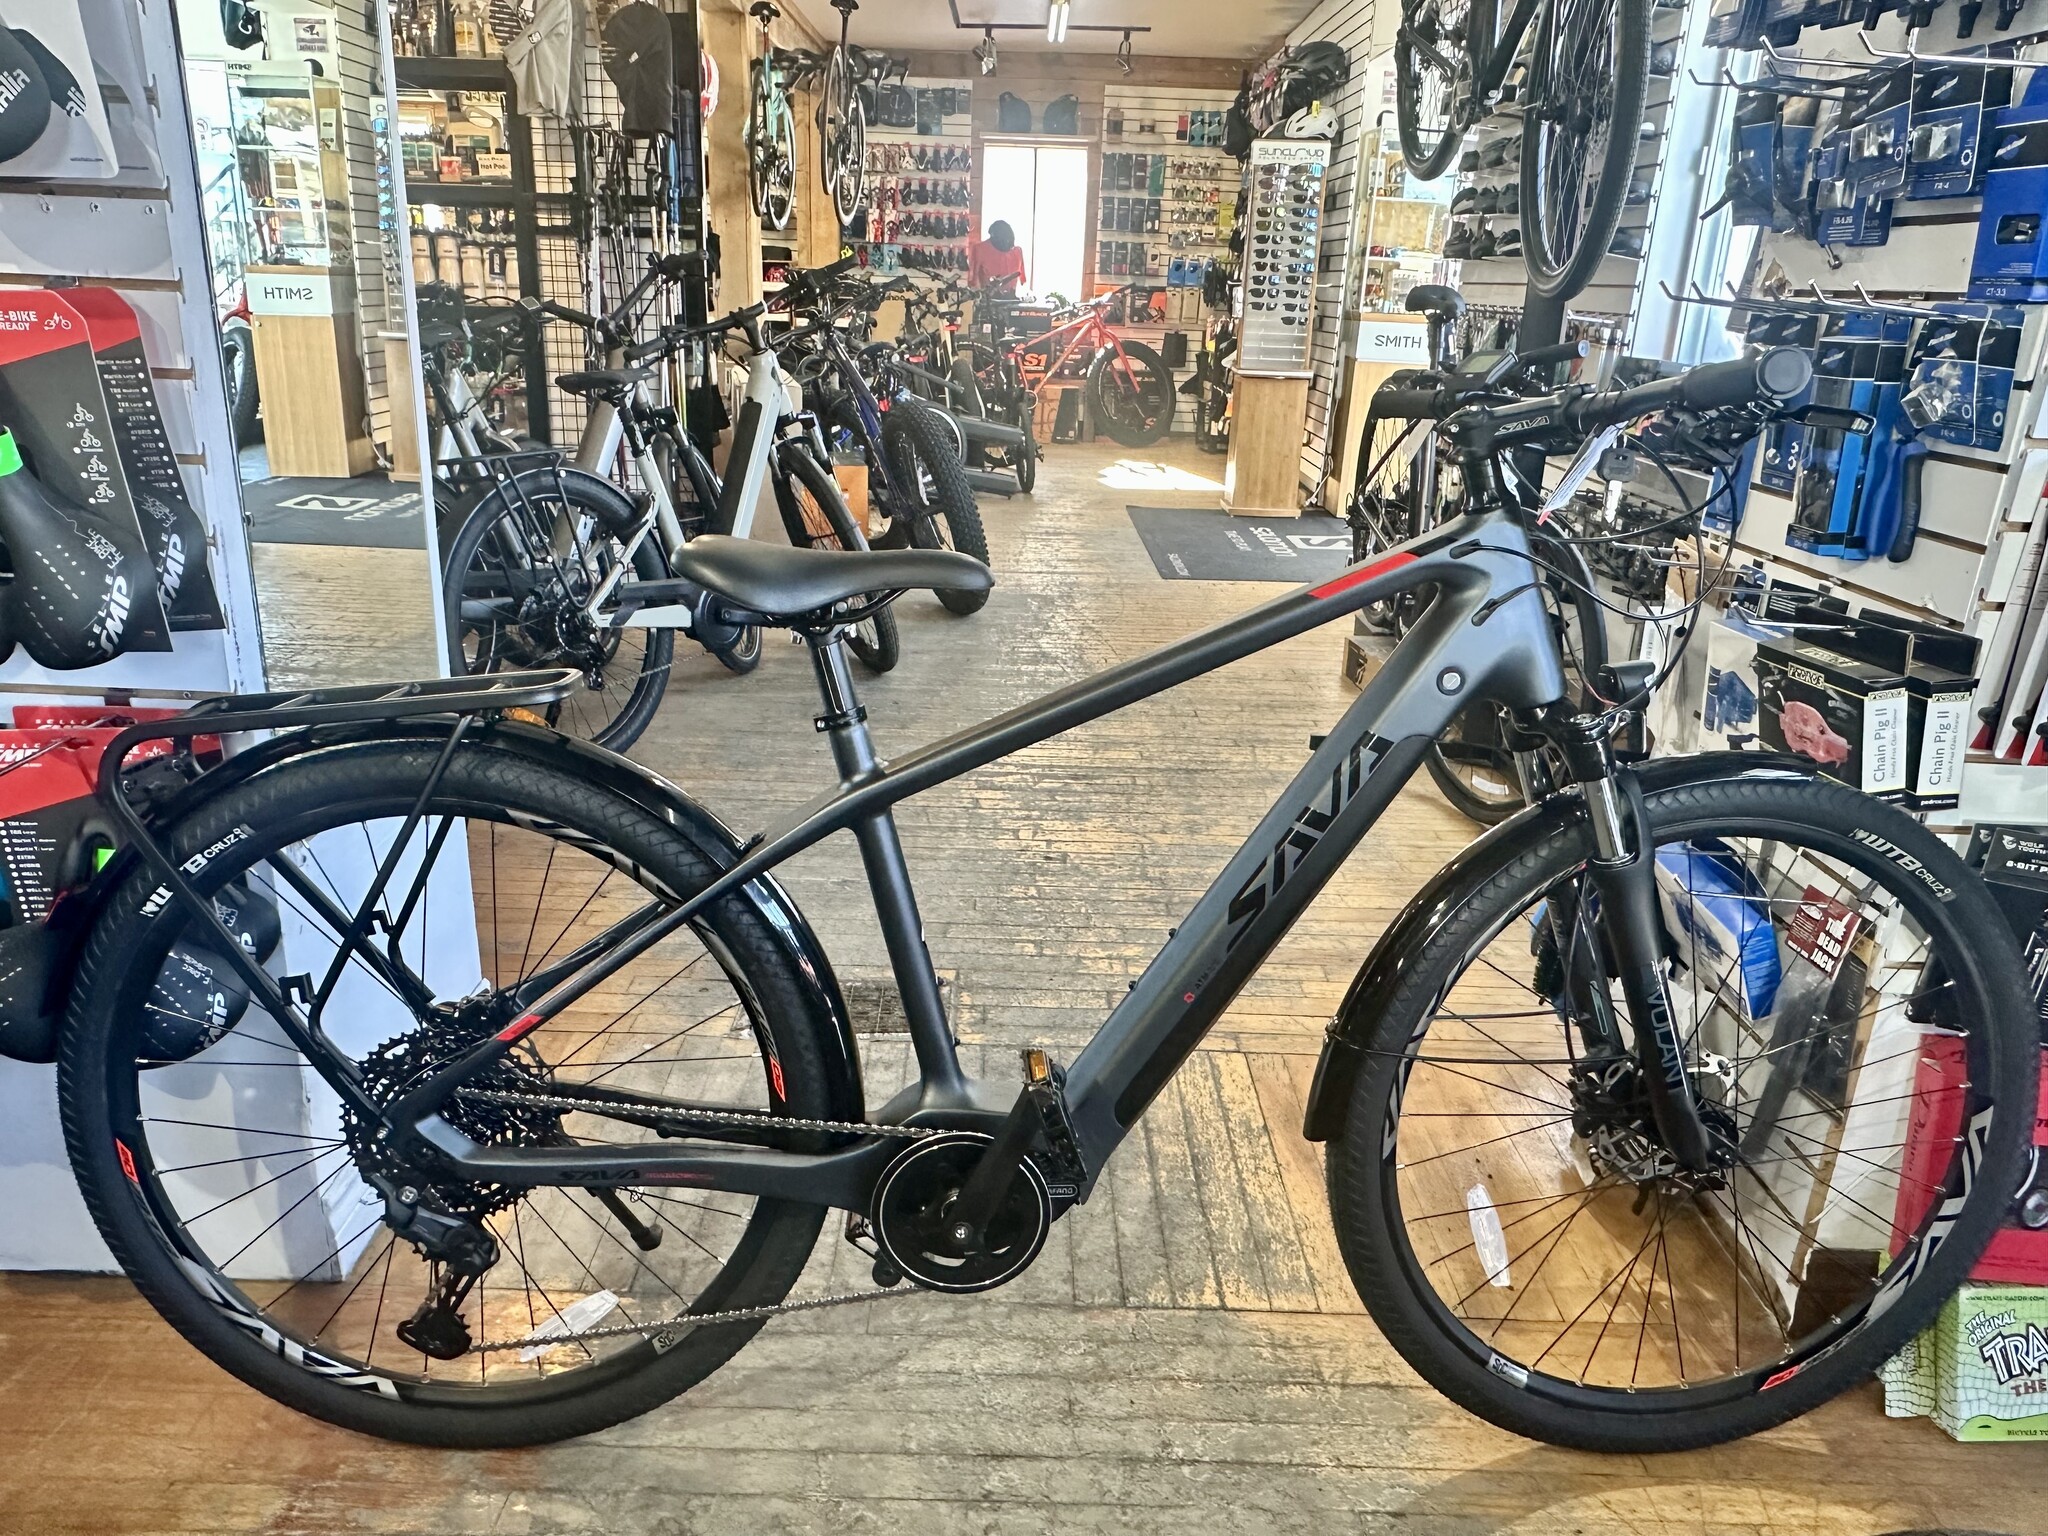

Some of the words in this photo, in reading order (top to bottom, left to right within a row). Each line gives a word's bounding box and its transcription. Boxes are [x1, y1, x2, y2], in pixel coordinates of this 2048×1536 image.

[0, 321, 30, 331] READY
[1374, 334, 1422, 349] SMITH
[1023, 352, 1048, 368] S1
[1494, 415, 1550, 436] SAVA
[101, 575, 131, 658] SMP
[1874, 719, 1890, 741] Pig
[1934, 722, 1952, 744] Pig
[1873, 744, 1886, 783] Chain
[1929, 748, 1946, 786] Chain
[203, 832, 239, 858] CRUZ
[1226, 729, 1395, 954] SAVA
[2018, 845, 2047, 855] TOOTH
[2019, 840, 2045, 849] WOLF
[1862, 833, 1923, 872] WTB
[1915, 867, 1945, 893] CRUZ
[1810, 947, 1836, 973] JACK
[1965, 1309, 1986, 1332] THE
[1967, 1308, 2017, 1348] ORIGINAL
[2010, 1379, 2048, 1397] THE
